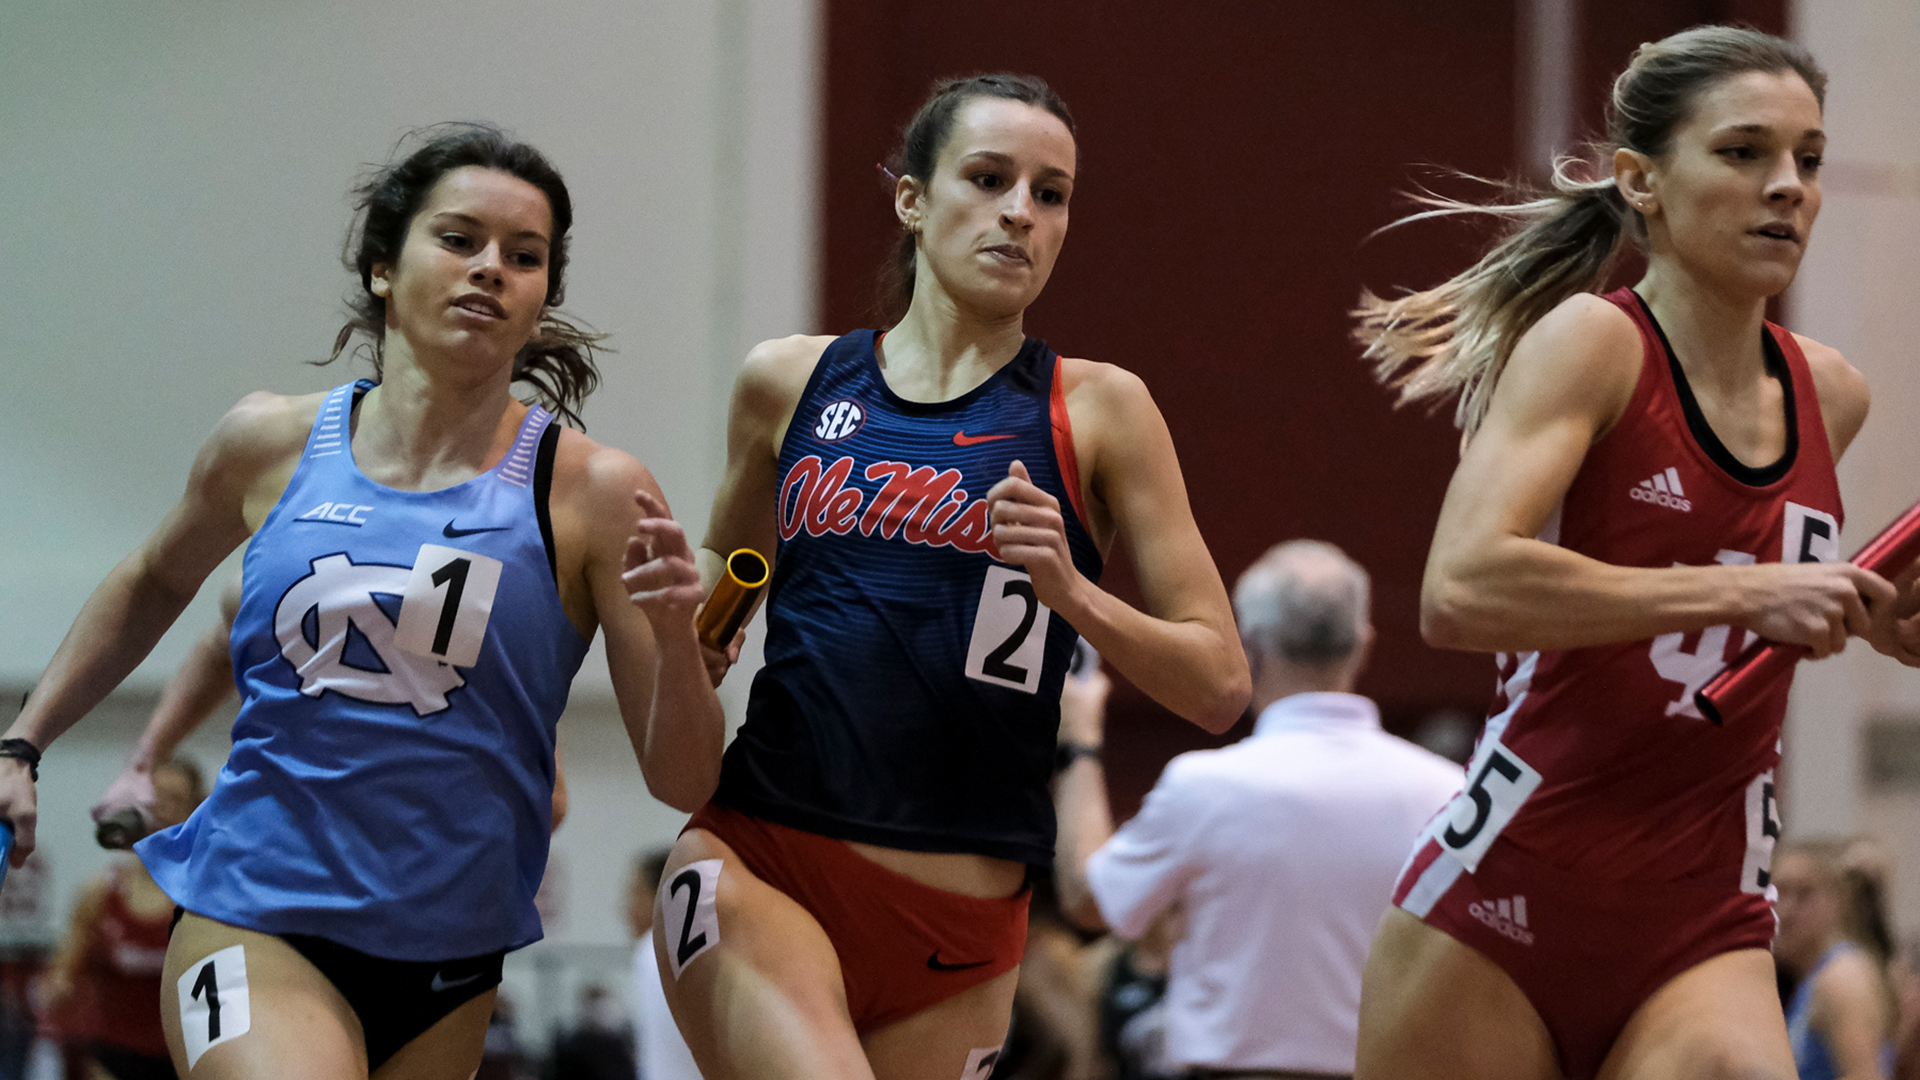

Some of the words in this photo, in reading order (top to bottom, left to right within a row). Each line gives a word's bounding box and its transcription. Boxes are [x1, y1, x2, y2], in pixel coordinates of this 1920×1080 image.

[814, 400, 862, 440] SEC
[300, 501, 376, 524] ACC
[779, 456, 863, 541] Ole
[860, 461, 1005, 563] Mis
[1629, 487, 1692, 512] adidas
[431, 557, 472, 656] 1
[982, 579, 1039, 685] 2
[1443, 749, 1523, 850] 5
[670, 869, 707, 968] 2
[1468, 902, 1535, 946] adidas
[190, 960, 221, 1044] 1
